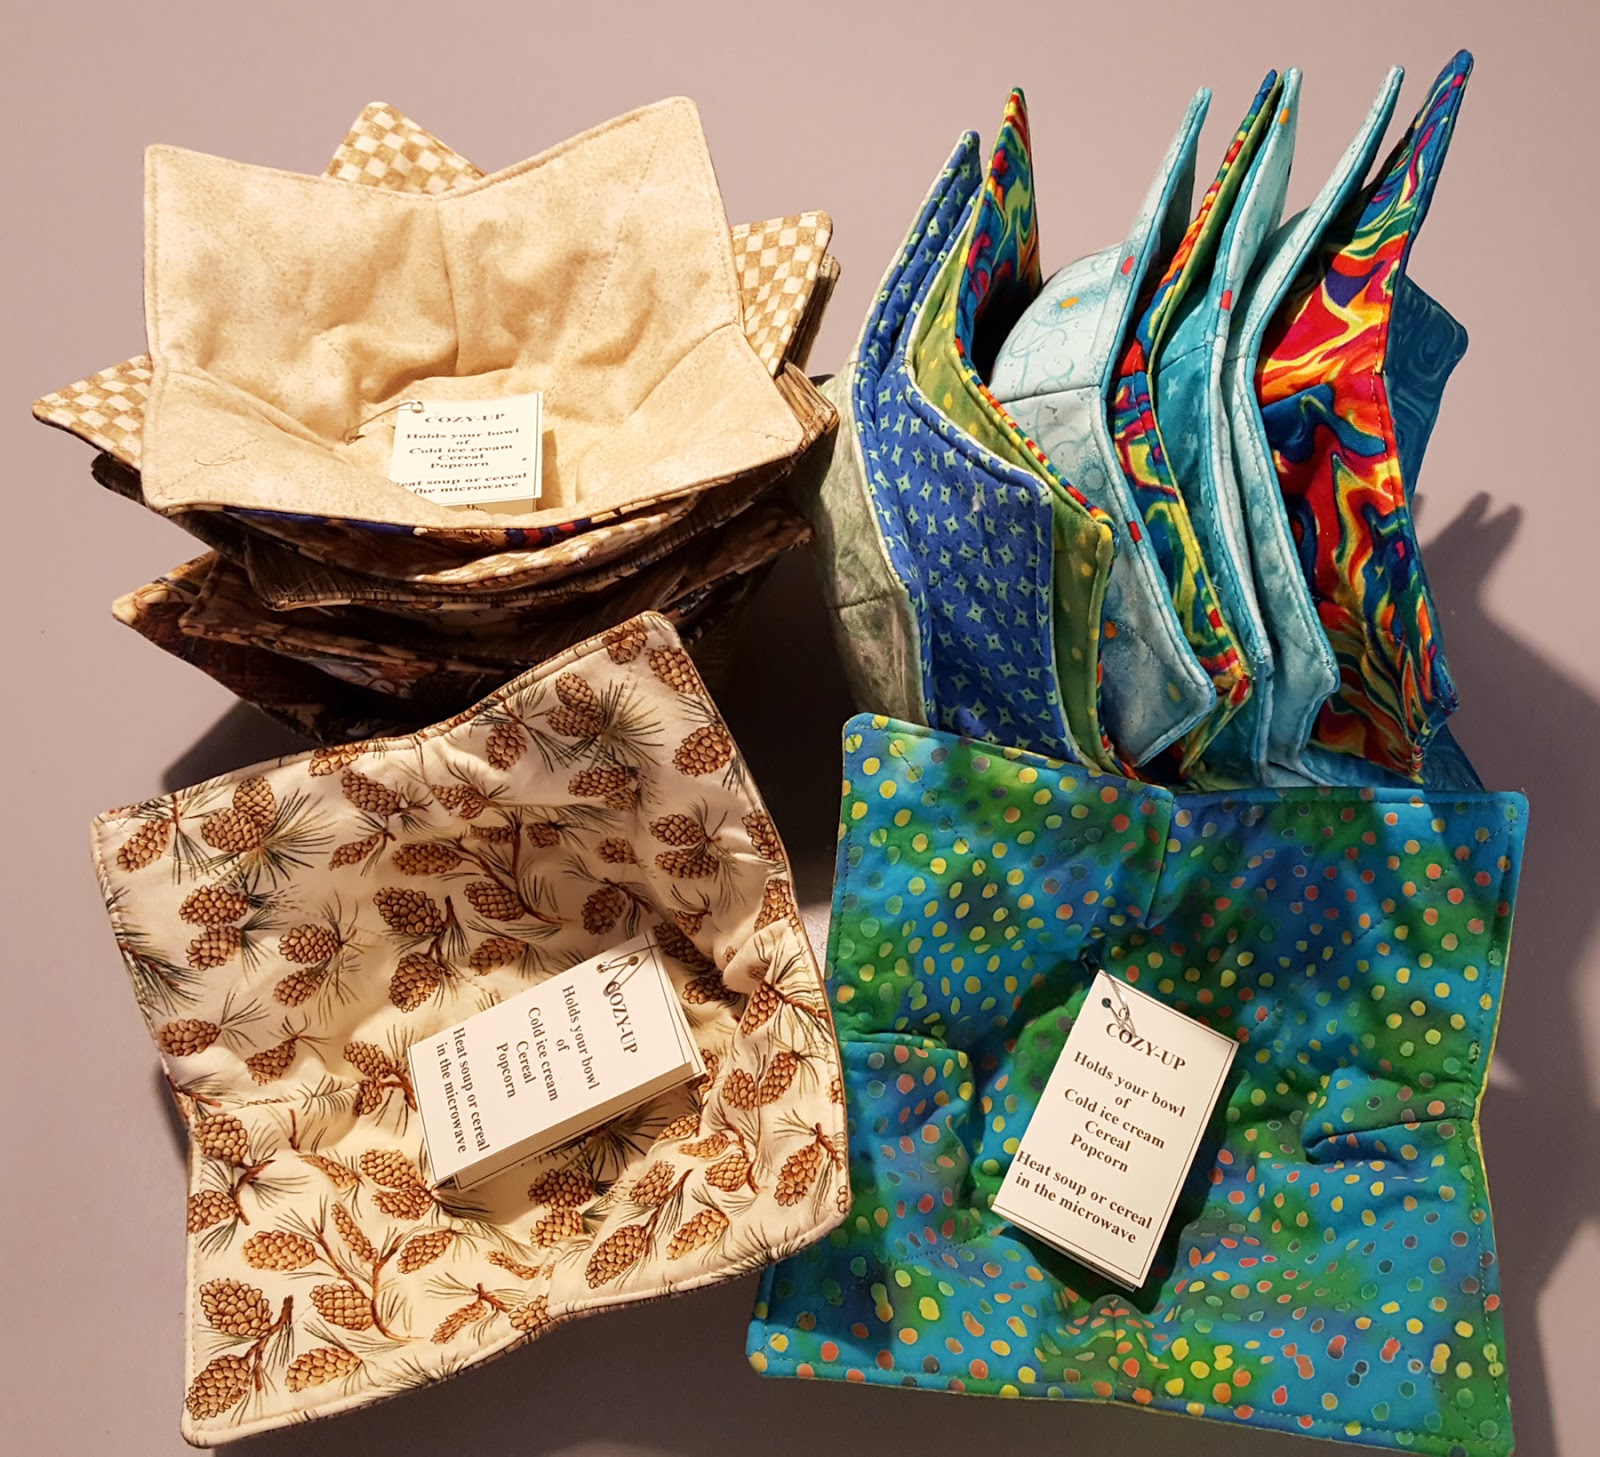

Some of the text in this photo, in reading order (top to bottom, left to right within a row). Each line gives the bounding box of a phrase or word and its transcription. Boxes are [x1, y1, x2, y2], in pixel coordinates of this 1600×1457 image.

[425, 413, 505, 423] COZY-UP
[488, 428, 519, 437] bowl
[430, 461, 489, 469] Popcorn
[437, 453, 484, 461] Cereal
[485, 473, 527, 482] cereal
[440, 482, 519, 493] microwave
[528, 1006, 558, 1101] Cold ice cream
[555, 1038, 570, 1052] of
[562, 985, 600, 1090] Holds your bowl
[1106, 1023, 1186, 1070] COZY-UP
[496, 1042, 516, 1098] Popcorn
[516, 1040, 536, 1084] Cereal
[436, 1043, 467, 1153] in the microwave
[453, 1027, 490, 1152] Heat soup or cereal
[1073, 1051, 1186, 1118] Holds your bowl
[1115, 1095, 1132, 1109] of
[1064, 1088, 1165, 1149] Cold ice cream
[1085, 1120, 1131, 1152] Cereal
[1070, 1133, 1128, 1173] Popcorn
[1015, 1172, 1137, 1244] in the microwave
[1016, 1150, 1153, 1229] Heat soup or cereal
